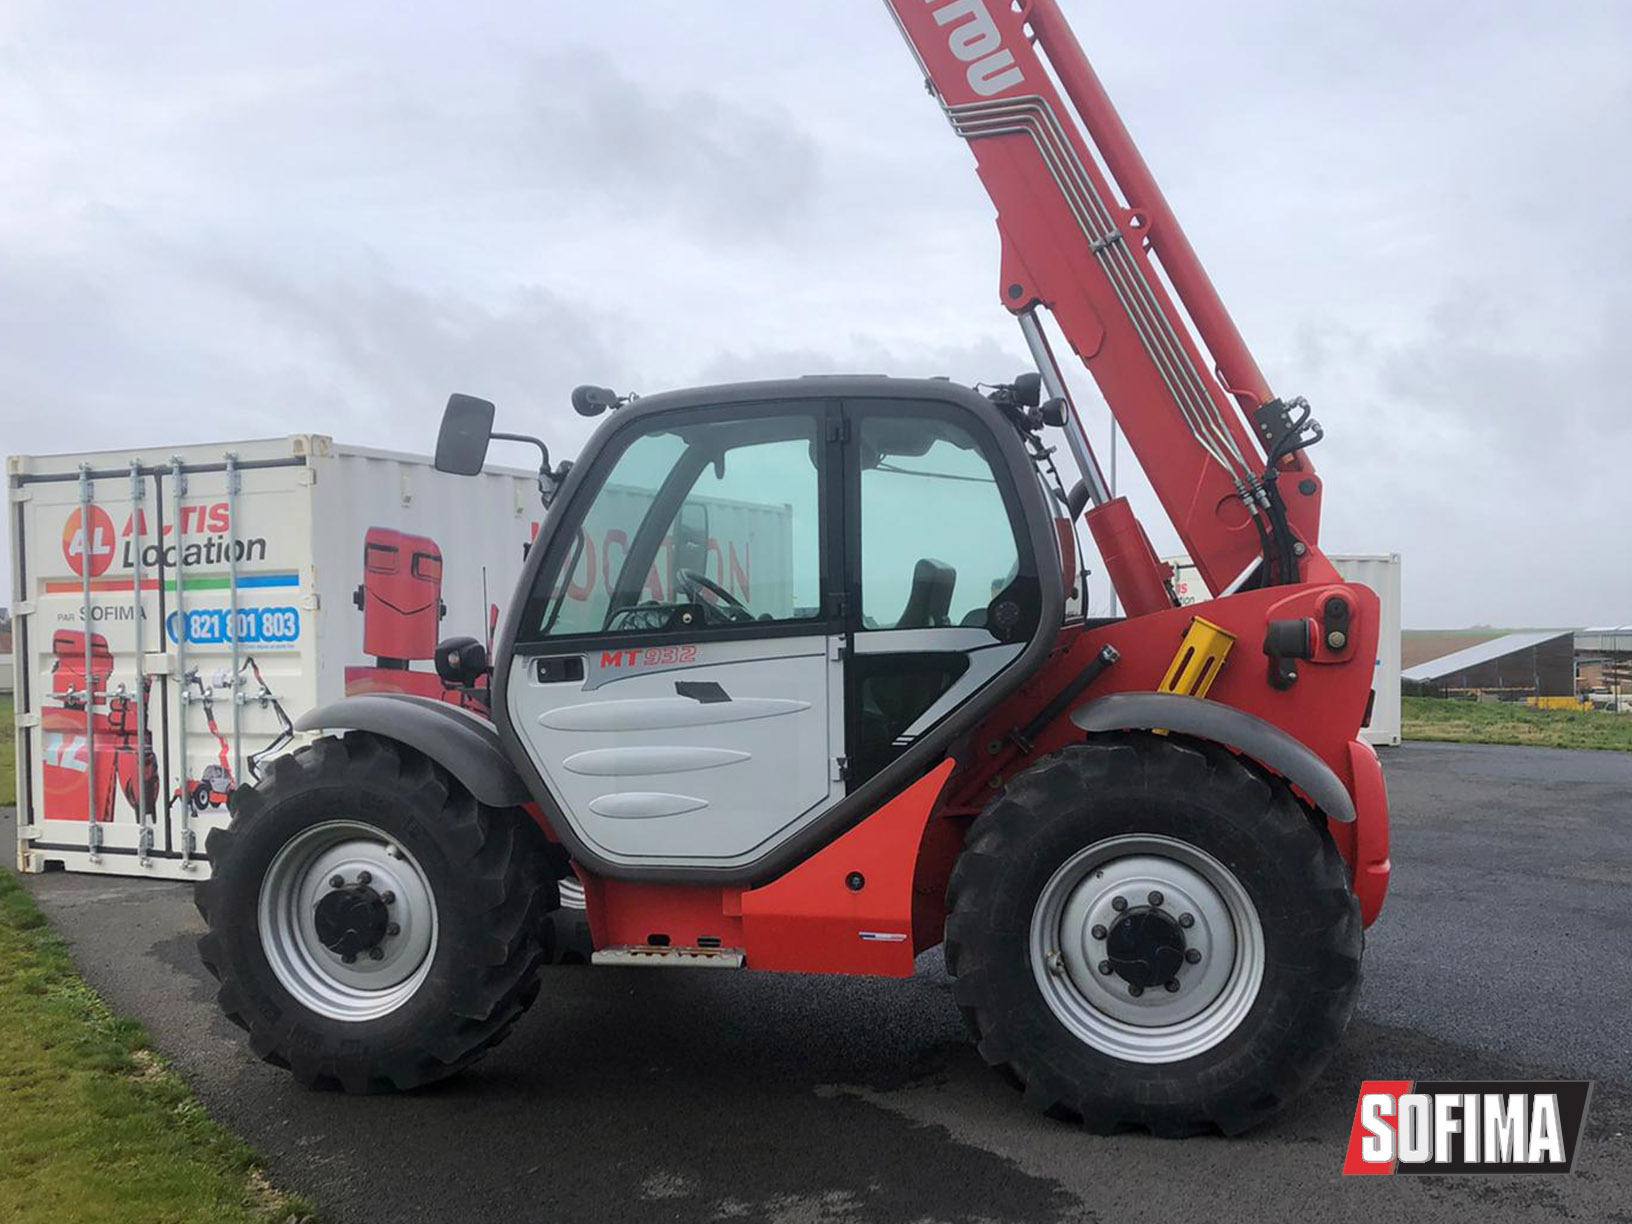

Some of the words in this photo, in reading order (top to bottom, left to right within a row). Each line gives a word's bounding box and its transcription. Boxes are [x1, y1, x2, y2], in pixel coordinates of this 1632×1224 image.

[924, 0, 1025, 96] TOU
[122, 502, 230, 537] ATIS
[69, 526, 111, 556] AL
[122, 535, 267, 568] Location
[57, 613, 75, 621] PAR
[190, 614, 220, 639] 821
[262, 611, 295, 637] 803
[601, 648, 642, 668] MT
[643, 645, 698, 666] 932
